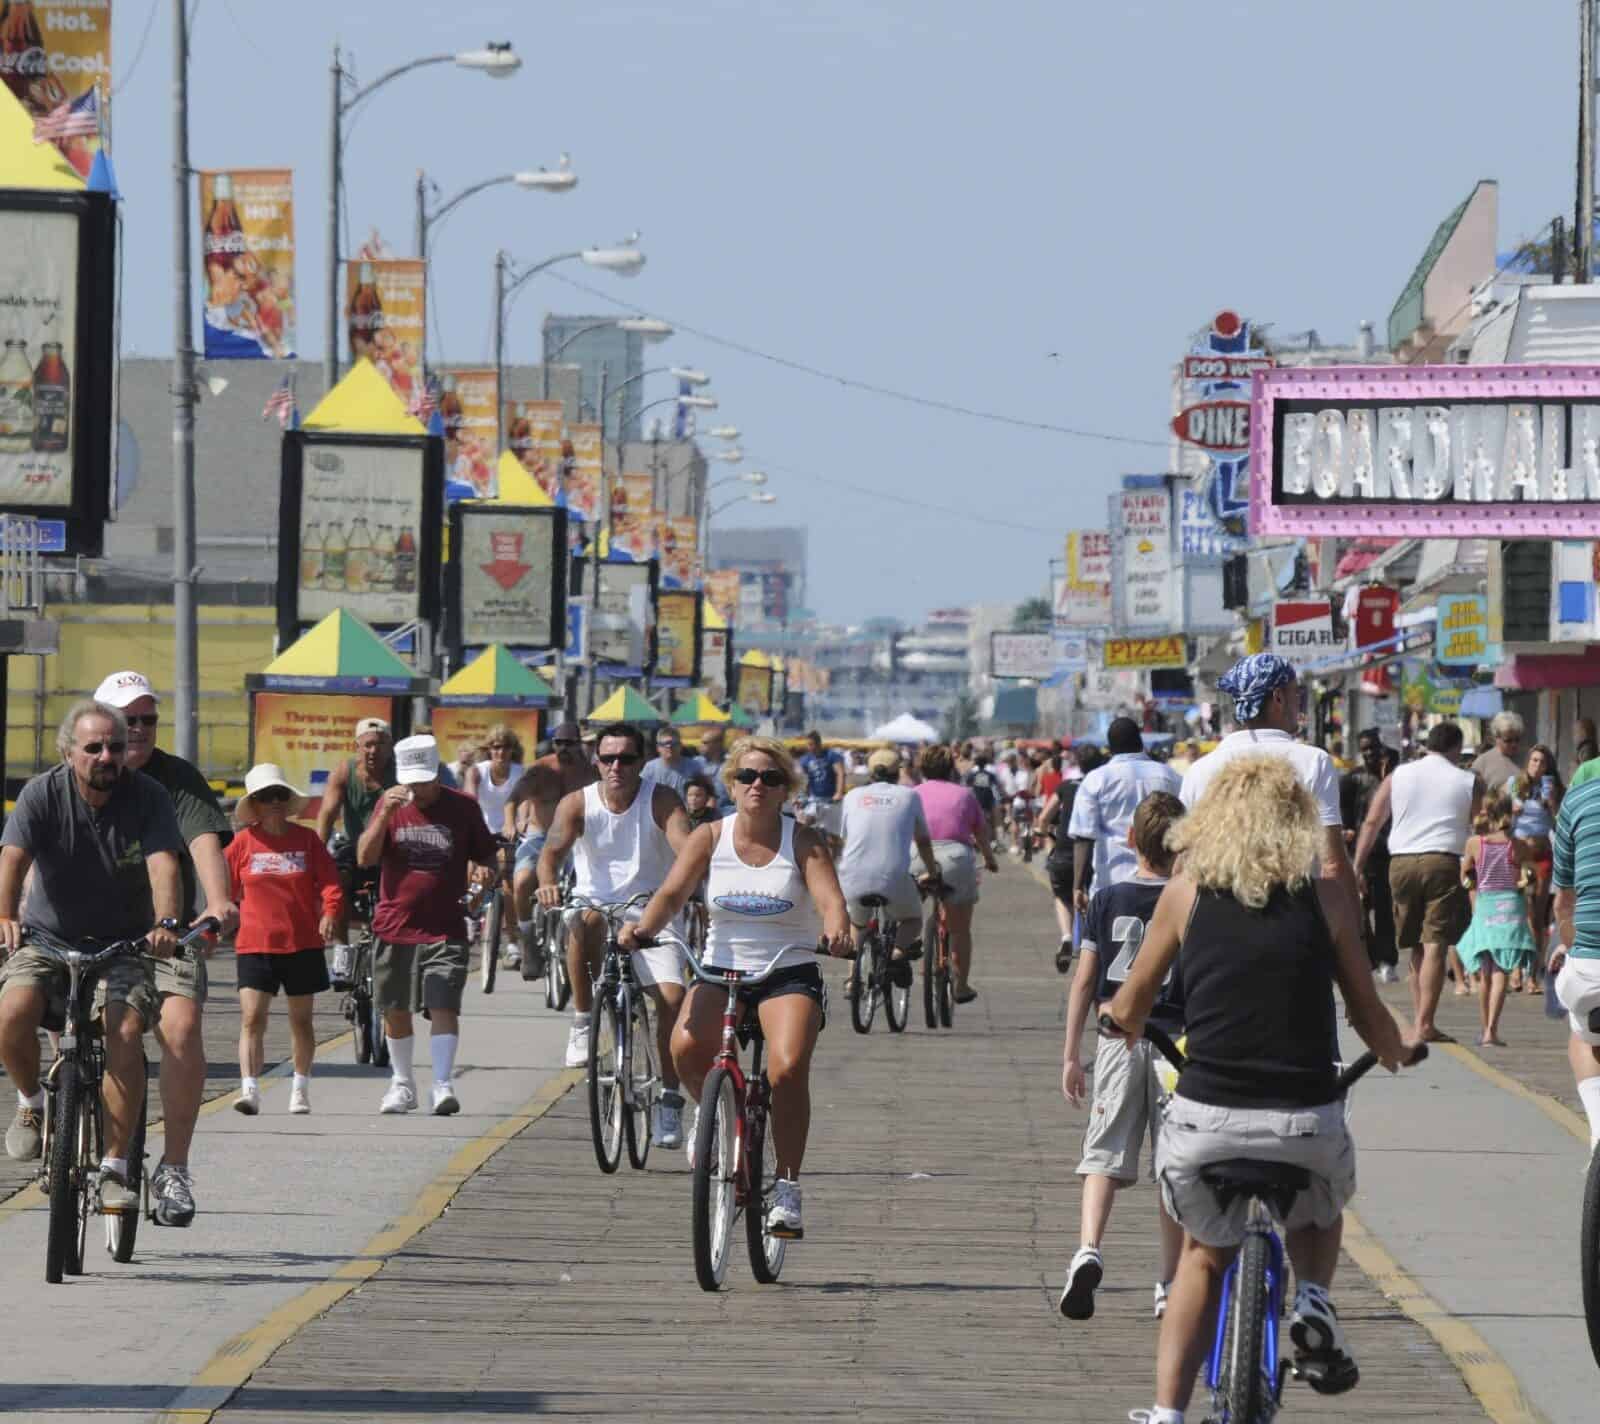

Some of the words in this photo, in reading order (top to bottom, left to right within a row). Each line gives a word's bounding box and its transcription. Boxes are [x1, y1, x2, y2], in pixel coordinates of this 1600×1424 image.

[46, 10, 97, 32] Hot.
[49, 52, 110, 73] Cool.
[1189, 407, 1249, 445] DINE
[1109, 637, 1181, 660] PIZZA
[286, 711, 329, 723] Throw
